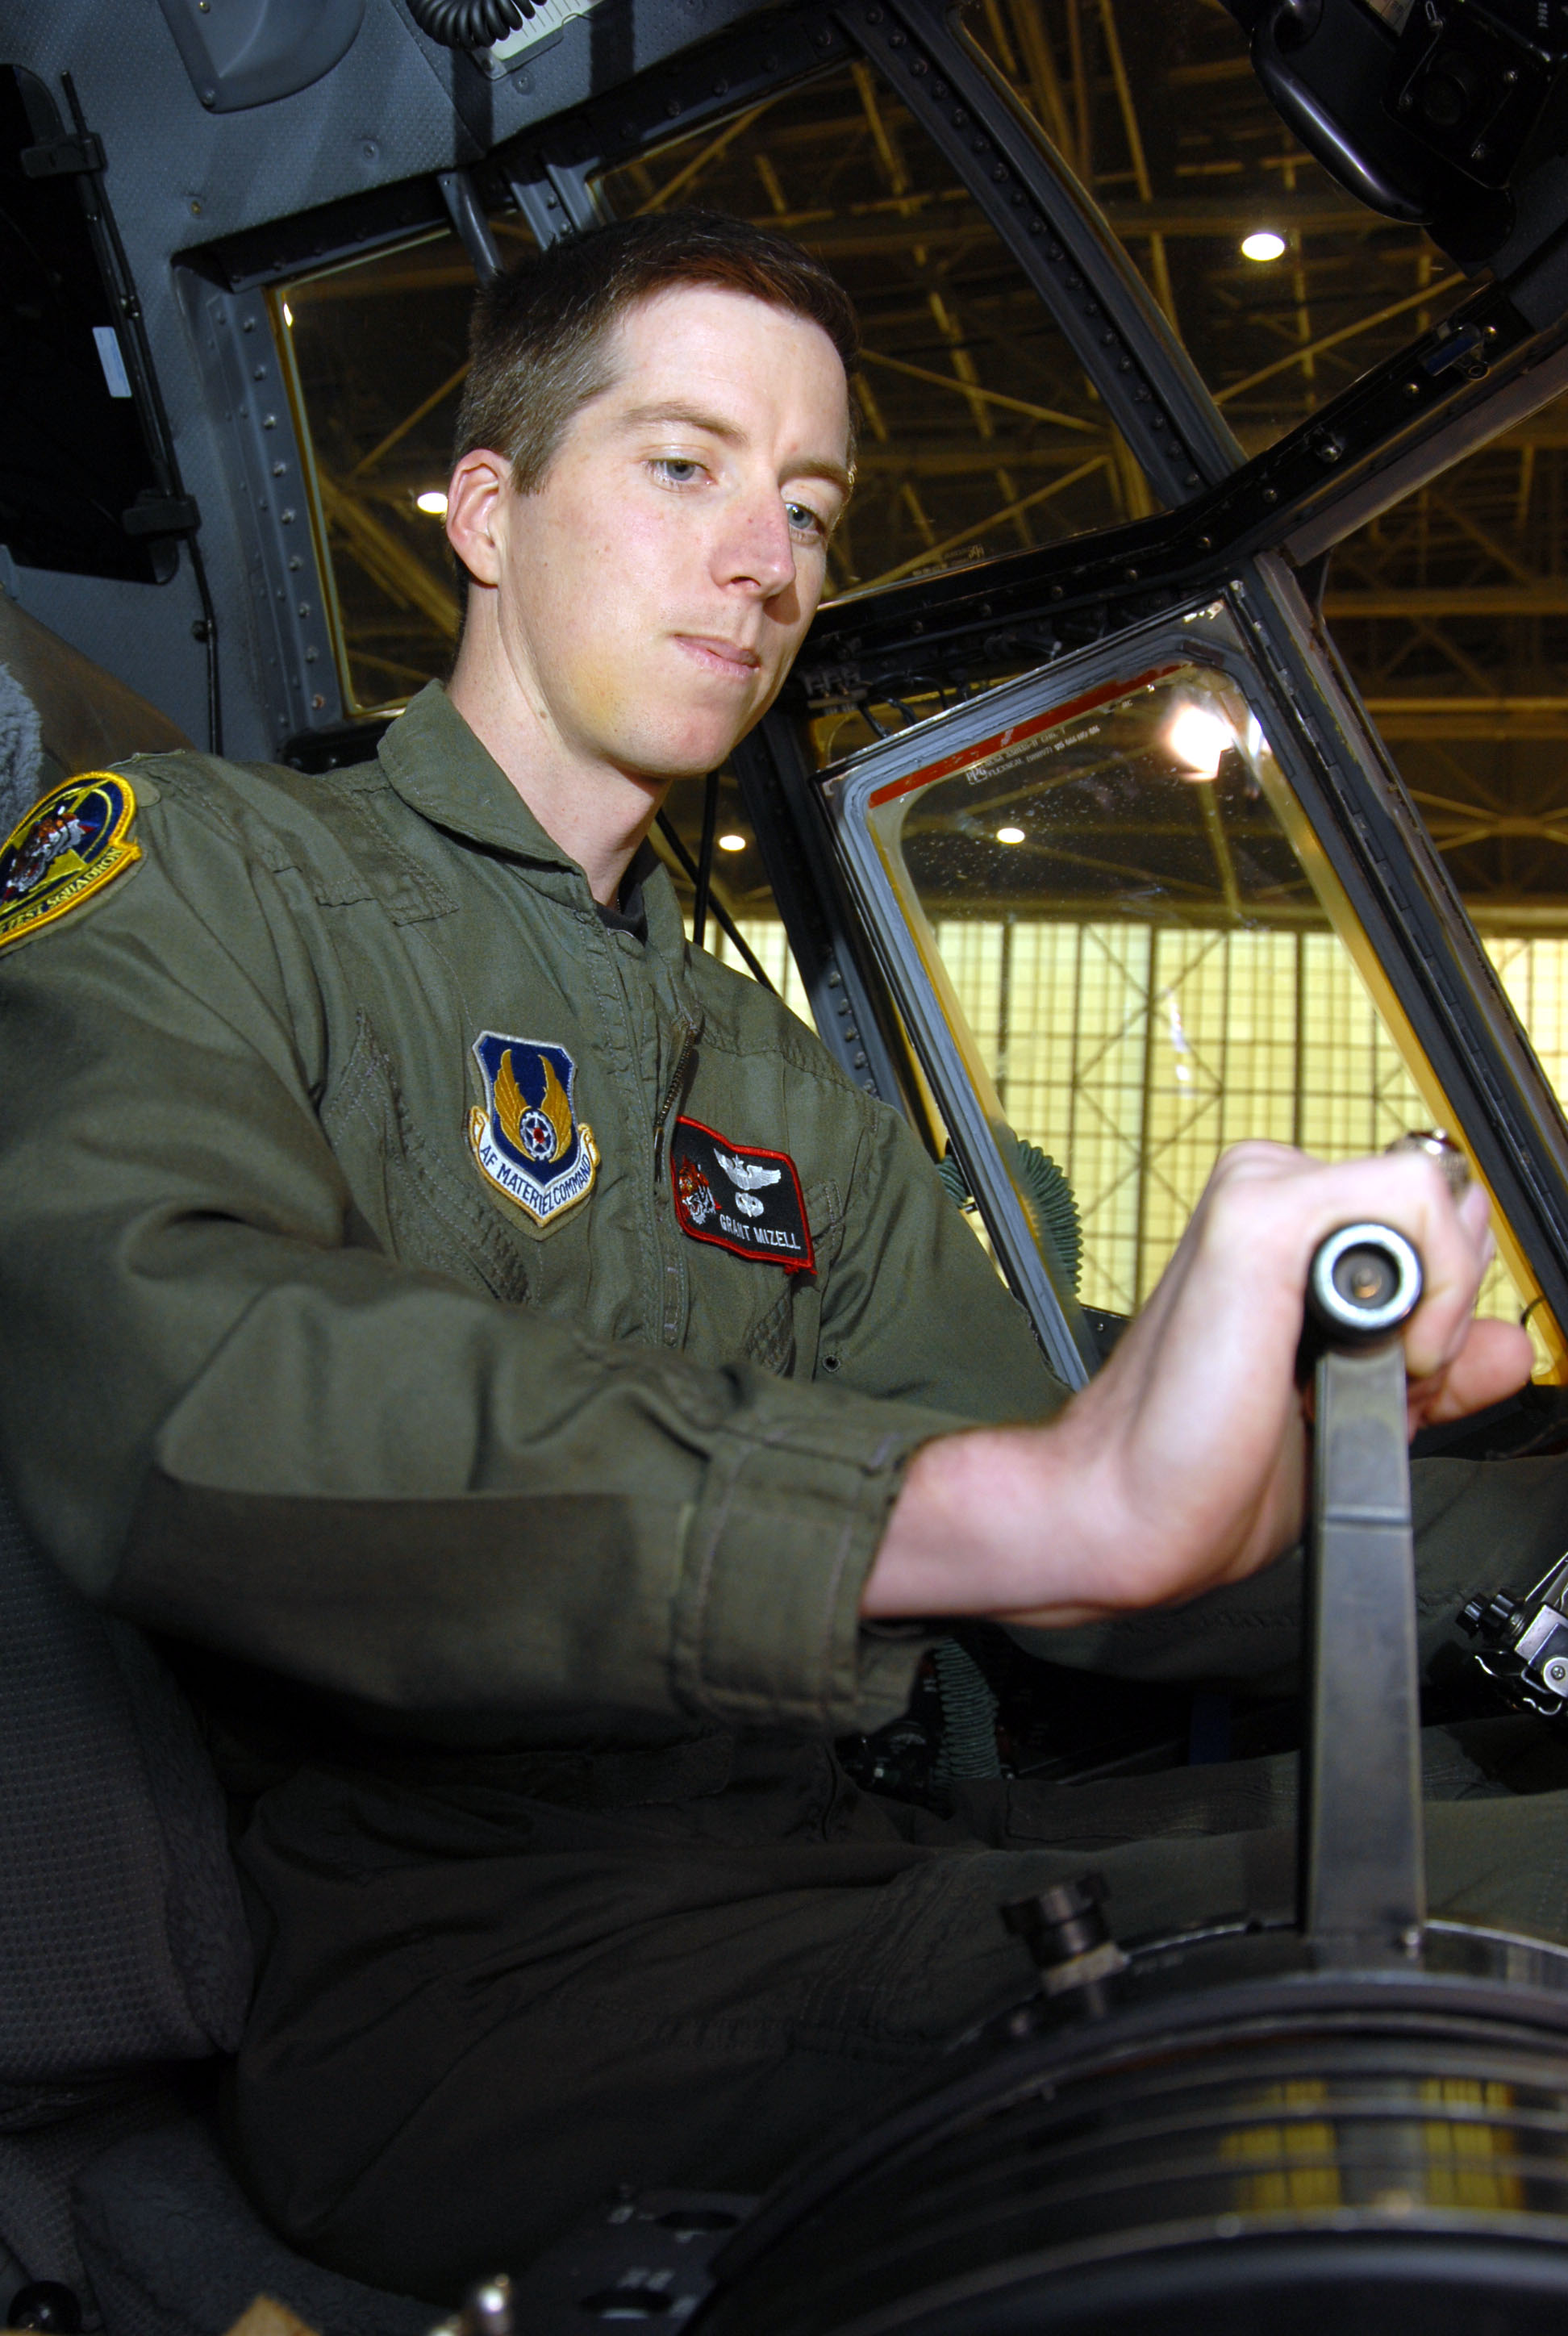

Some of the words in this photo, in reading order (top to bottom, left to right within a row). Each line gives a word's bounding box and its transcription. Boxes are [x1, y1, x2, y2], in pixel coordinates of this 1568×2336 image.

[8, 903, 44, 930] TEST
[46, 848, 123, 909] SQUADRON
[480, 1146, 498, 1167] AF
[497, 1163, 555, 1216] MATERIEL
[553, 1153, 592, 1206] COMMAND
[719, 1213, 751, 1242] GRANT
[753, 1226, 802, 1250] MIZELL
